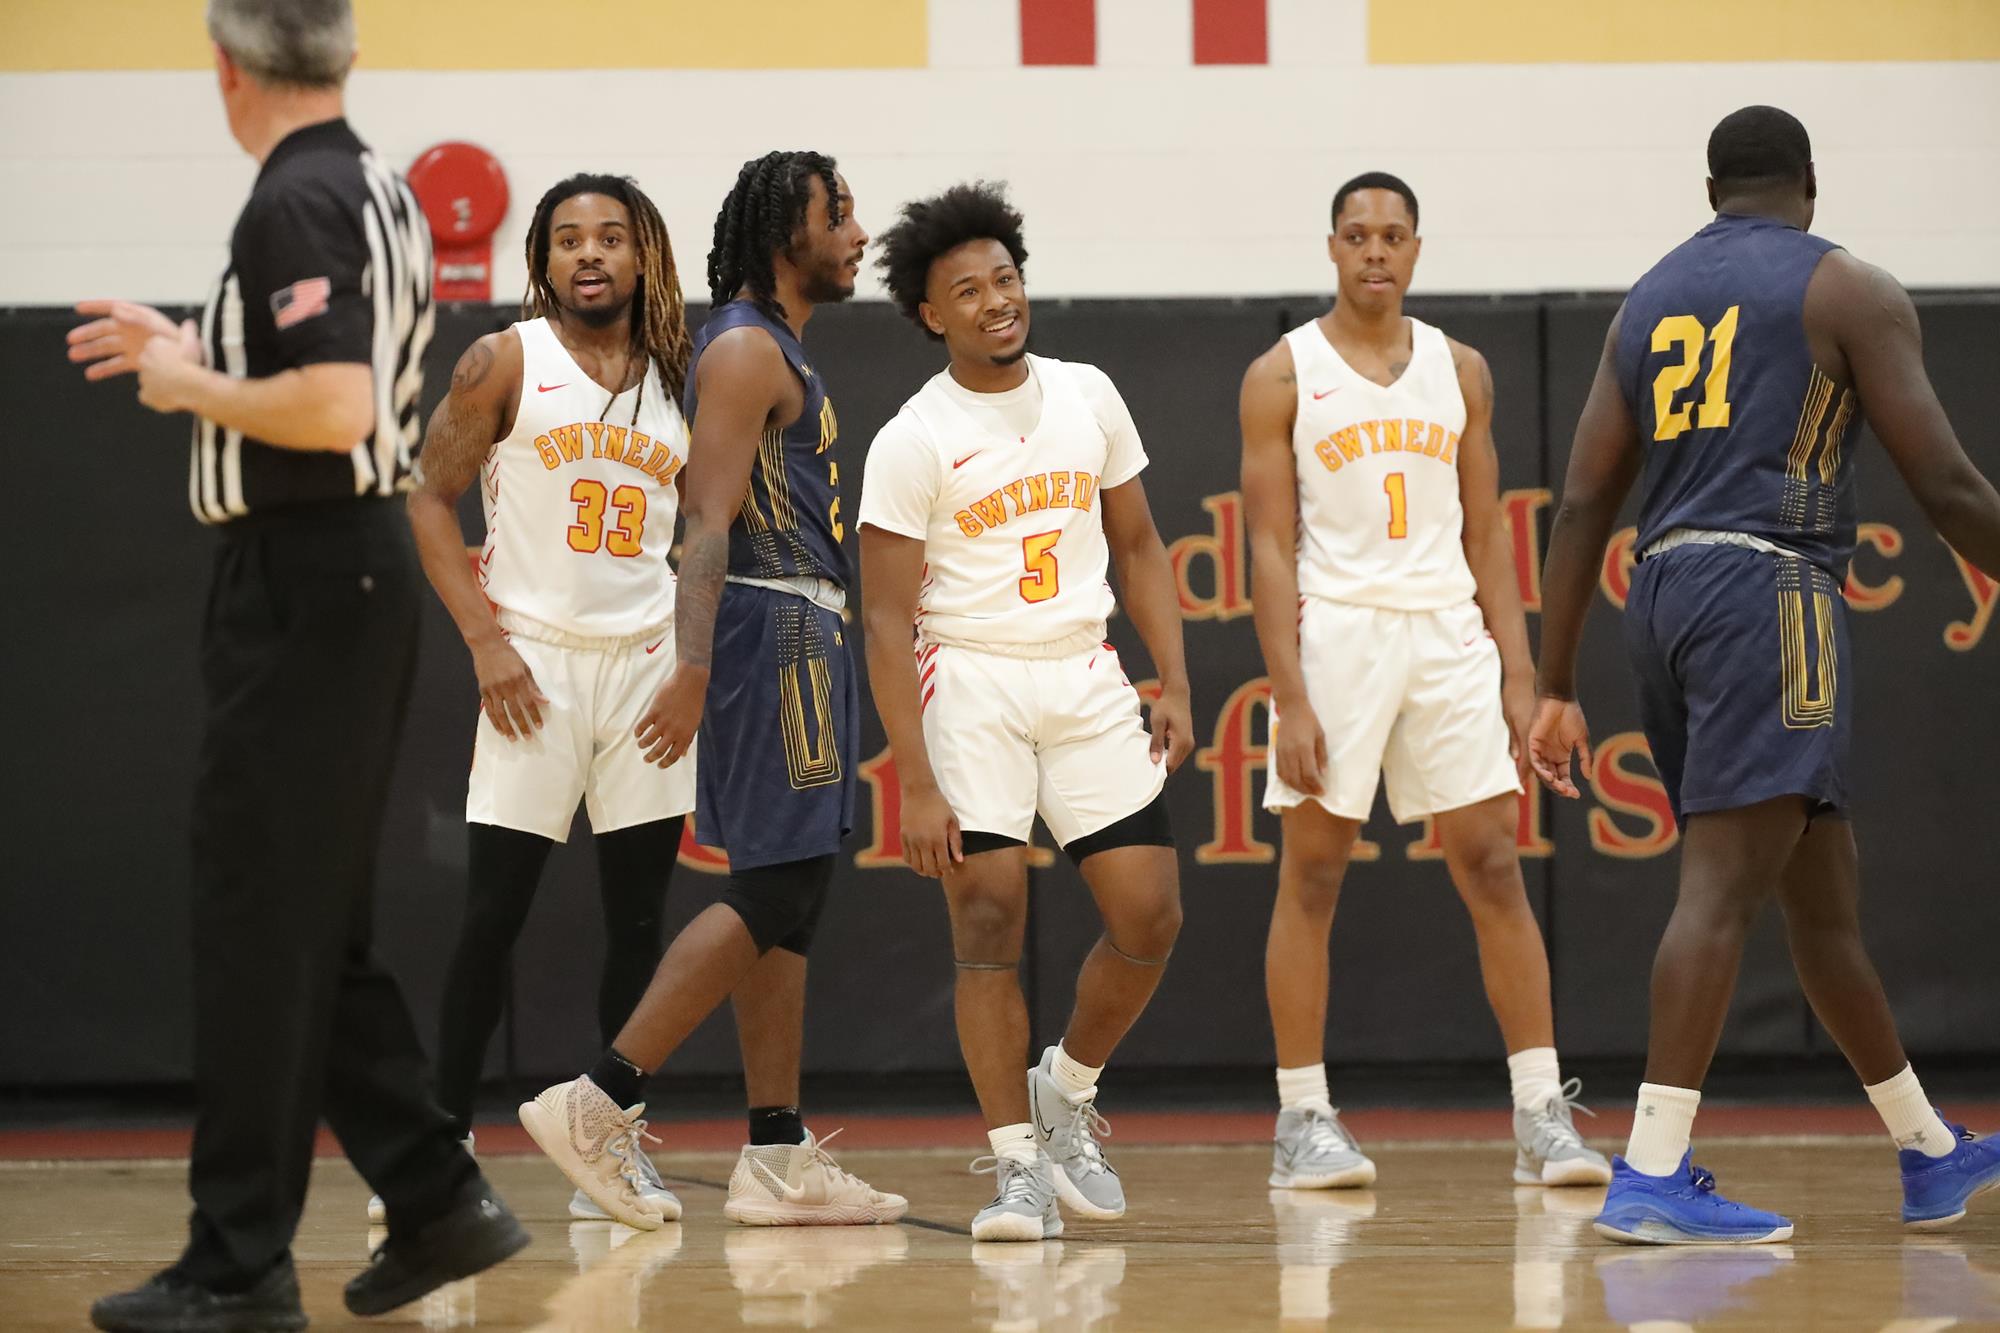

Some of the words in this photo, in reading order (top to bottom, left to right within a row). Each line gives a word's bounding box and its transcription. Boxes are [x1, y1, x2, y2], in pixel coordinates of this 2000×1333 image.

[1651, 304, 1740, 441] 21
[567, 478, 647, 557] 33
[954, 471, 1101, 538] GWYNED
[1384, 472, 1408, 540] 1
[1019, 529, 1062, 604] 5
